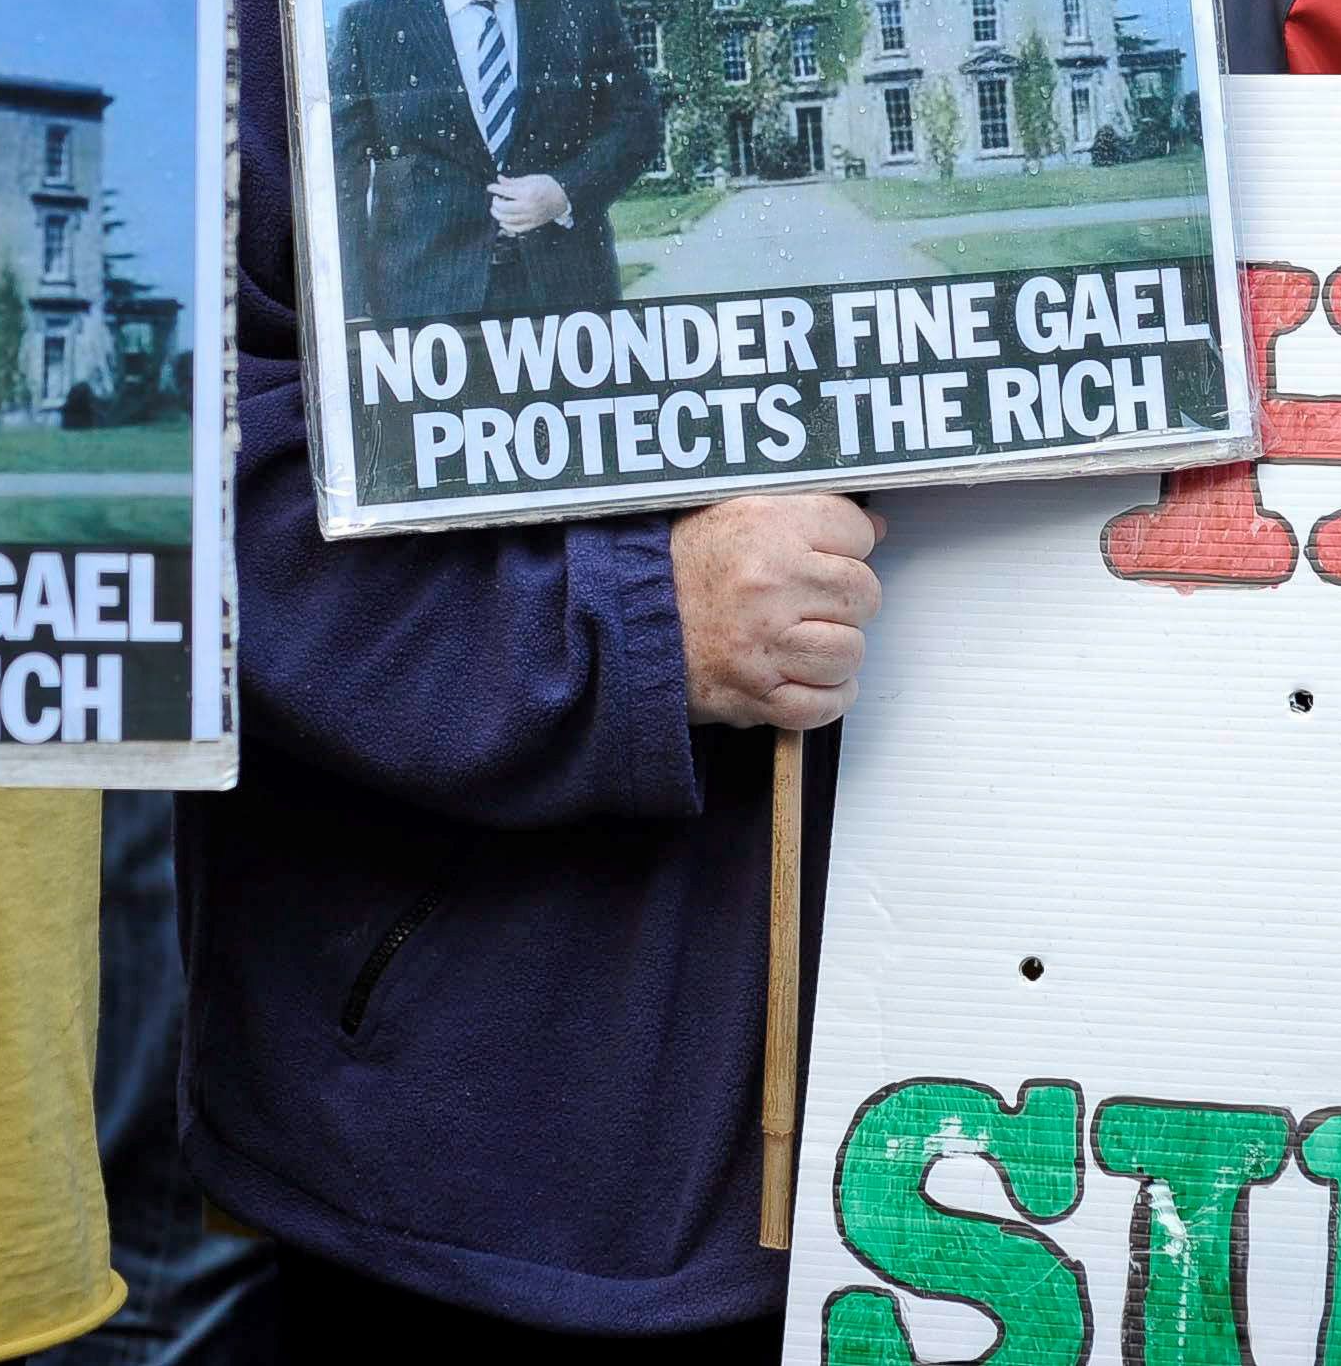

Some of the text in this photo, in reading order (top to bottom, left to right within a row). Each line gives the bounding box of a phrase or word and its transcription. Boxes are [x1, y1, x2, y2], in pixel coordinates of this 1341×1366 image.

[358, 266, 1211, 406] NO WONDER FINE GAEL
[412, 355, 1169, 490] PROTECTS THE RICH
